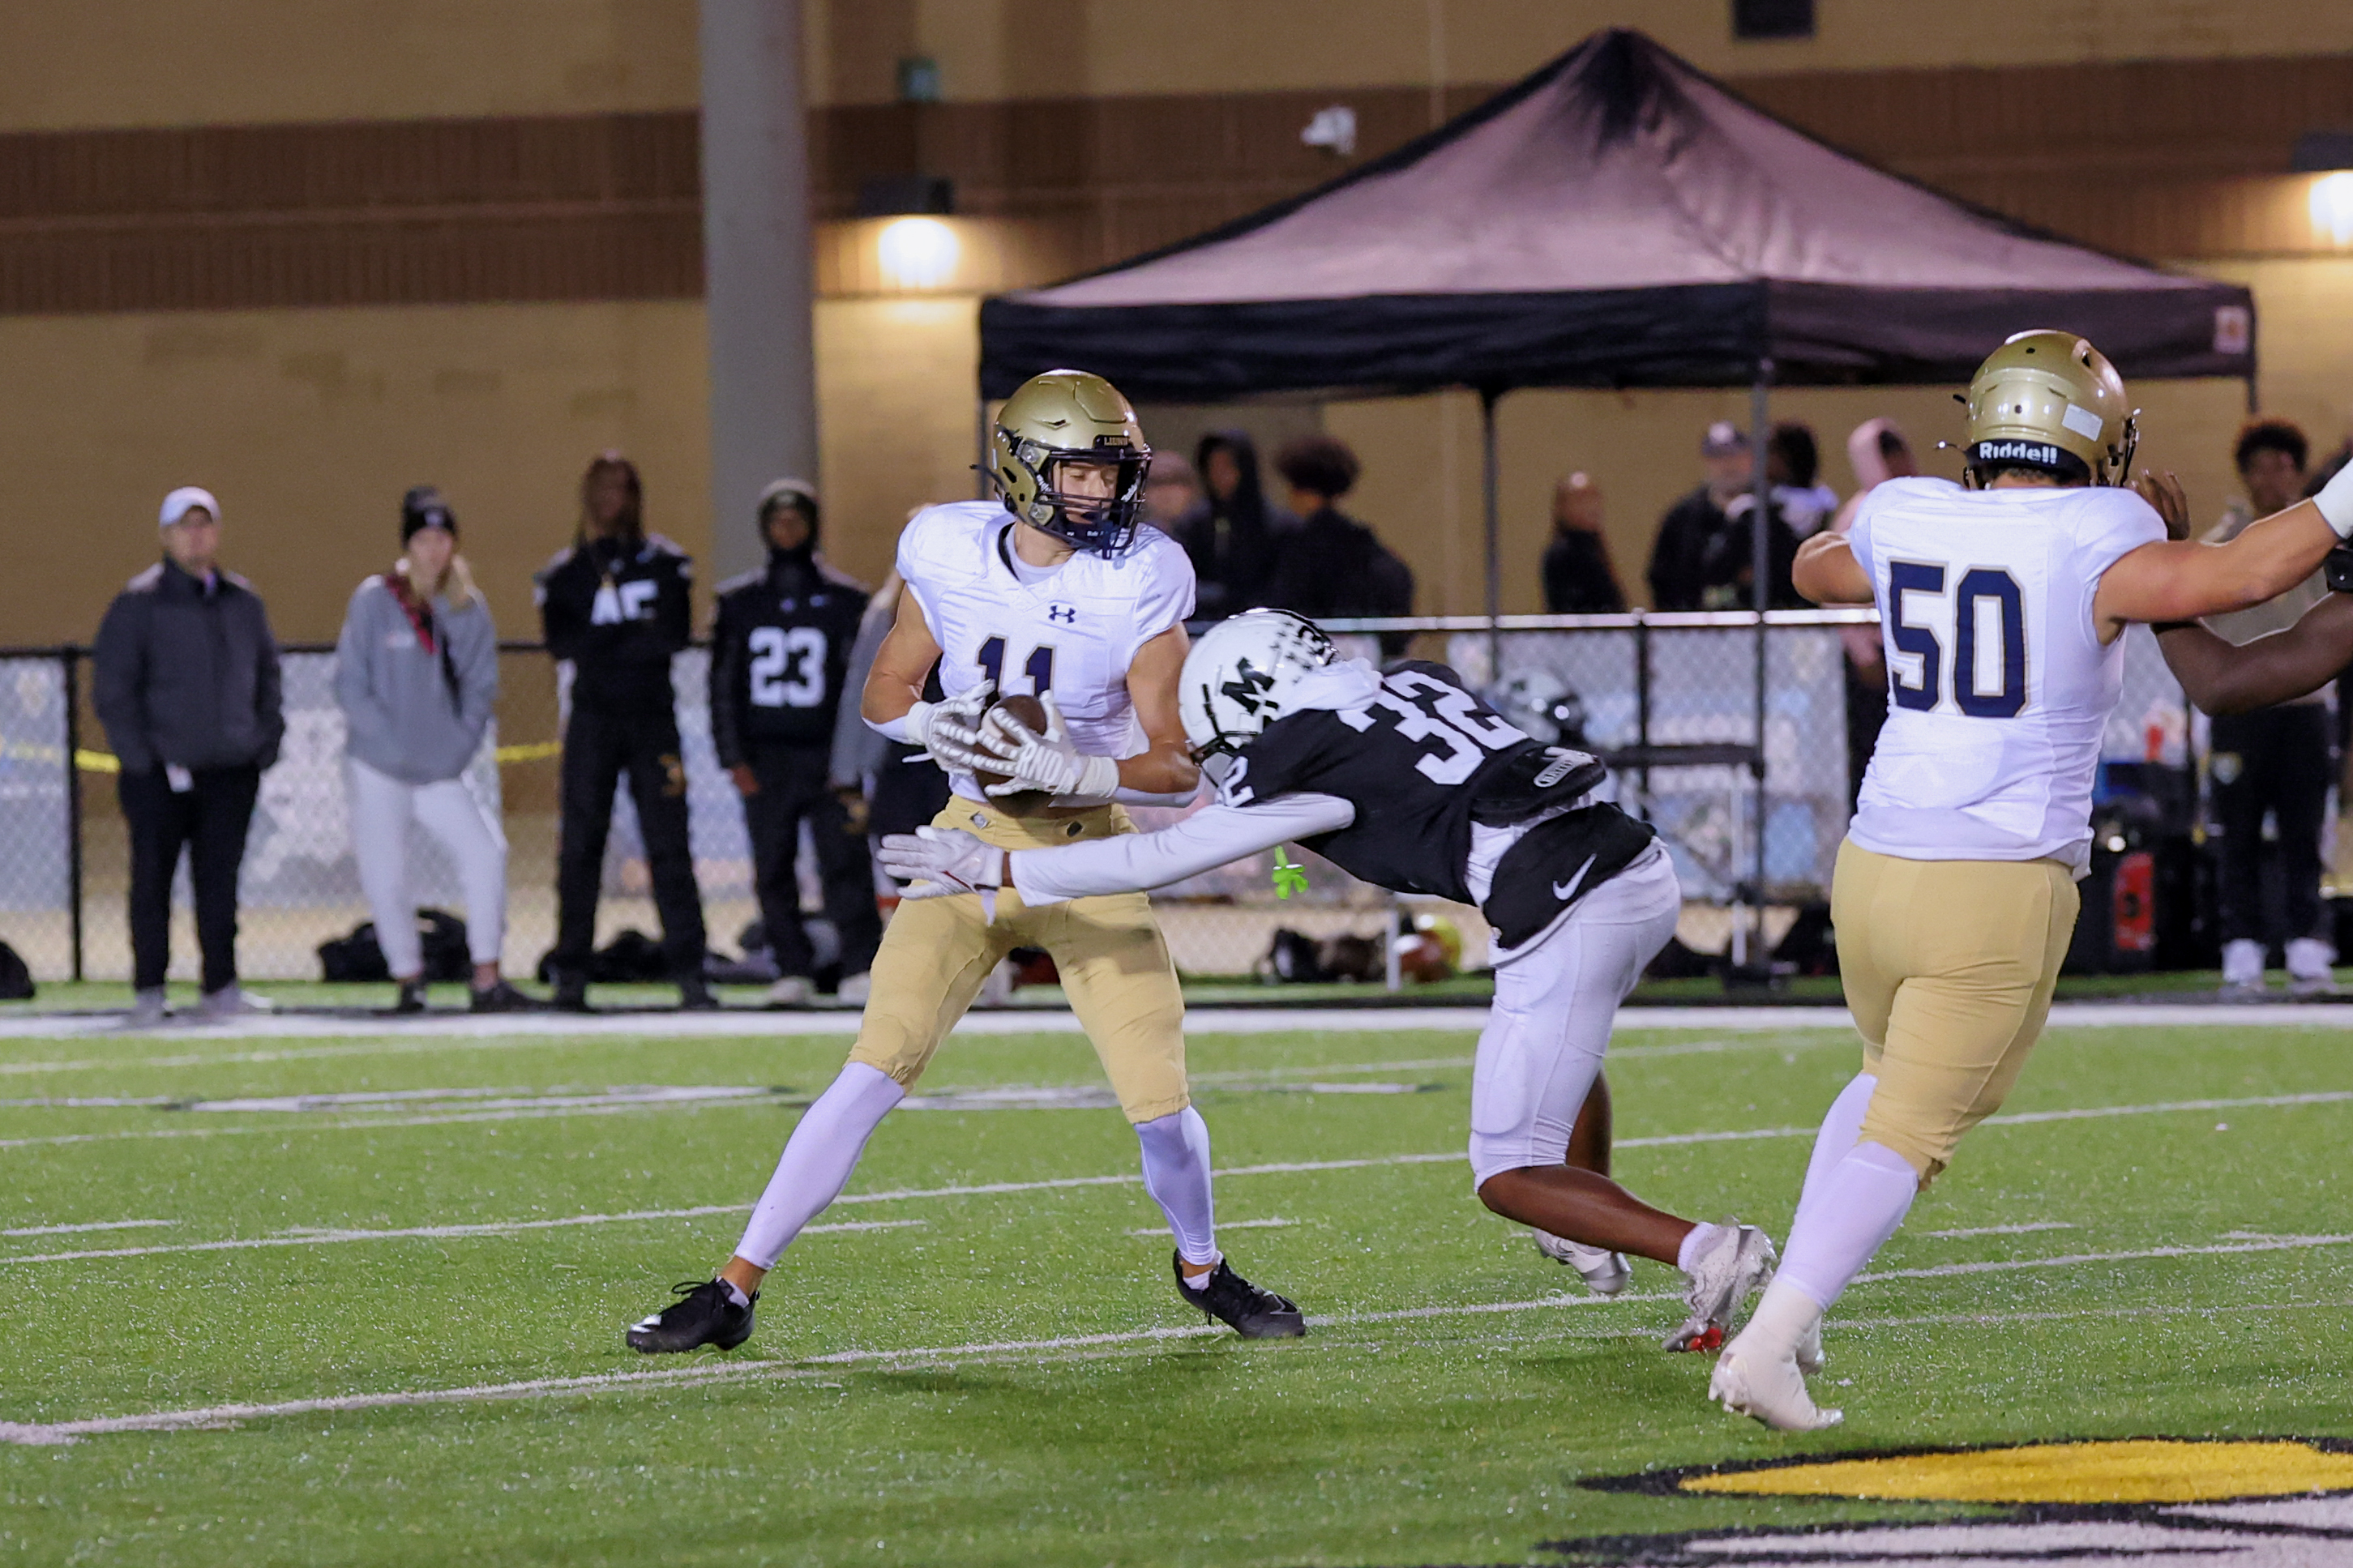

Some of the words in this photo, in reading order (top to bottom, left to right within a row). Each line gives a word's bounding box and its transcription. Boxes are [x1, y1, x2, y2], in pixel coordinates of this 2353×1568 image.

[1979, 442, 2057, 464] Riddell
[748, 626, 828, 707] 23
[976, 634, 1057, 702] 11
[1888, 556, 2030, 718] 50
[1221, 657, 1275, 716] M
[1336, 670, 1529, 786] 32
